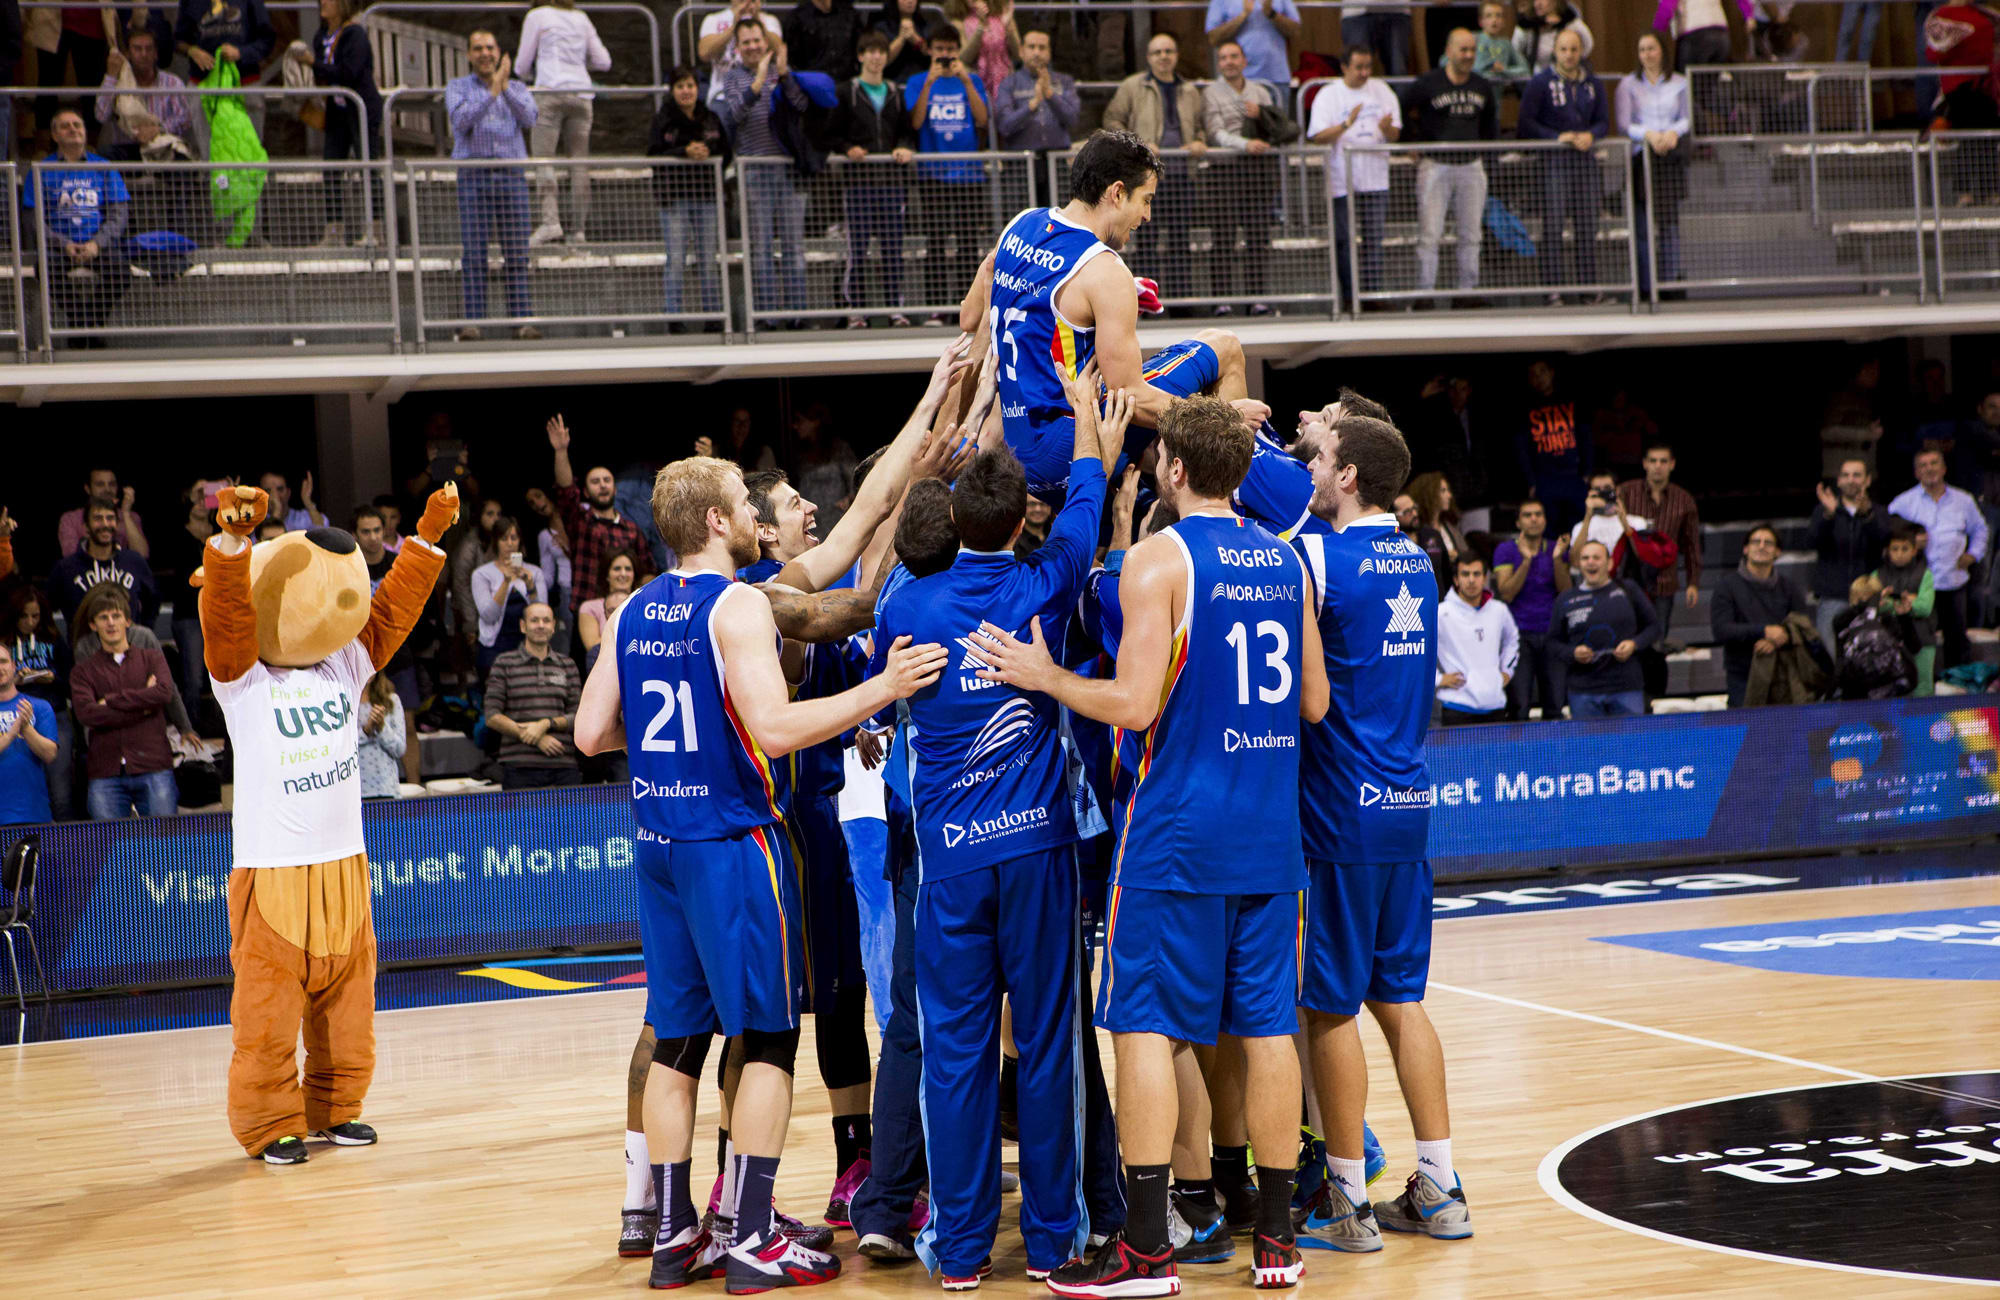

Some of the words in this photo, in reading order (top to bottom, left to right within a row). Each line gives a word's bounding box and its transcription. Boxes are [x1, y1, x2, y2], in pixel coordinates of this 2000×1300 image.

[1003, 233, 1065, 272] NAVARRO
[990, 305, 1027, 381] 15
[1529, 402, 1575, 434] STAY
[1217, 546, 1283, 568] BOGRIS
[74, 564, 134, 592] TOKYO
[644, 602, 693, 623] GREEN
[1225, 620, 1293, 705] 13
[1382, 638, 1425, 657] luanvi
[274, 692, 353, 738] URSA
[641, 679, 699, 752] 21
[1240, 729, 1295, 748] Andorra
[650, 779, 709, 798] Andorra
[1496, 764, 1695, 803] MoraBanc
[967, 806, 1048, 839] Andorra
[968, 819, 1050, 846] www.visitandorra.com
[1653, 1122, 2000, 1163] orra.com
